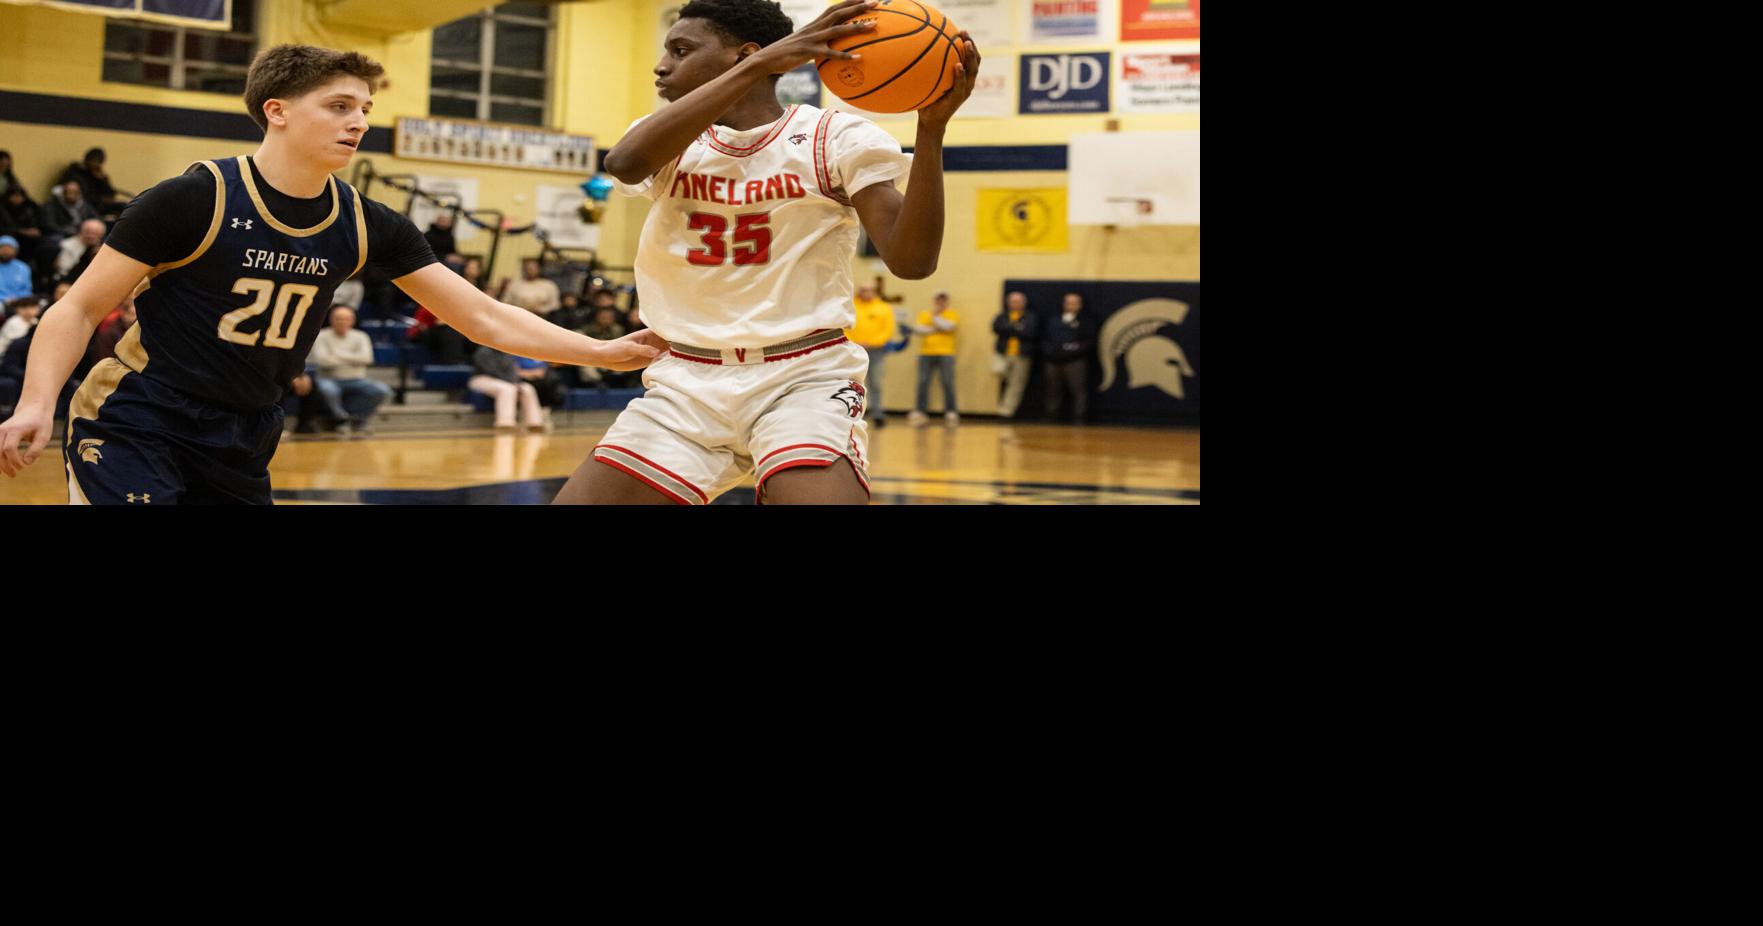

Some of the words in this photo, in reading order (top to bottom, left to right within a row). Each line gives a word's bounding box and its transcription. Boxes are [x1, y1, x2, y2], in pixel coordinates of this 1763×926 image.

[1029, 54, 1103, 99] DJD
[242, 248, 328, 276] SPARTANS
[686, 211, 773, 266] 35
[217, 277, 319, 350] 20
